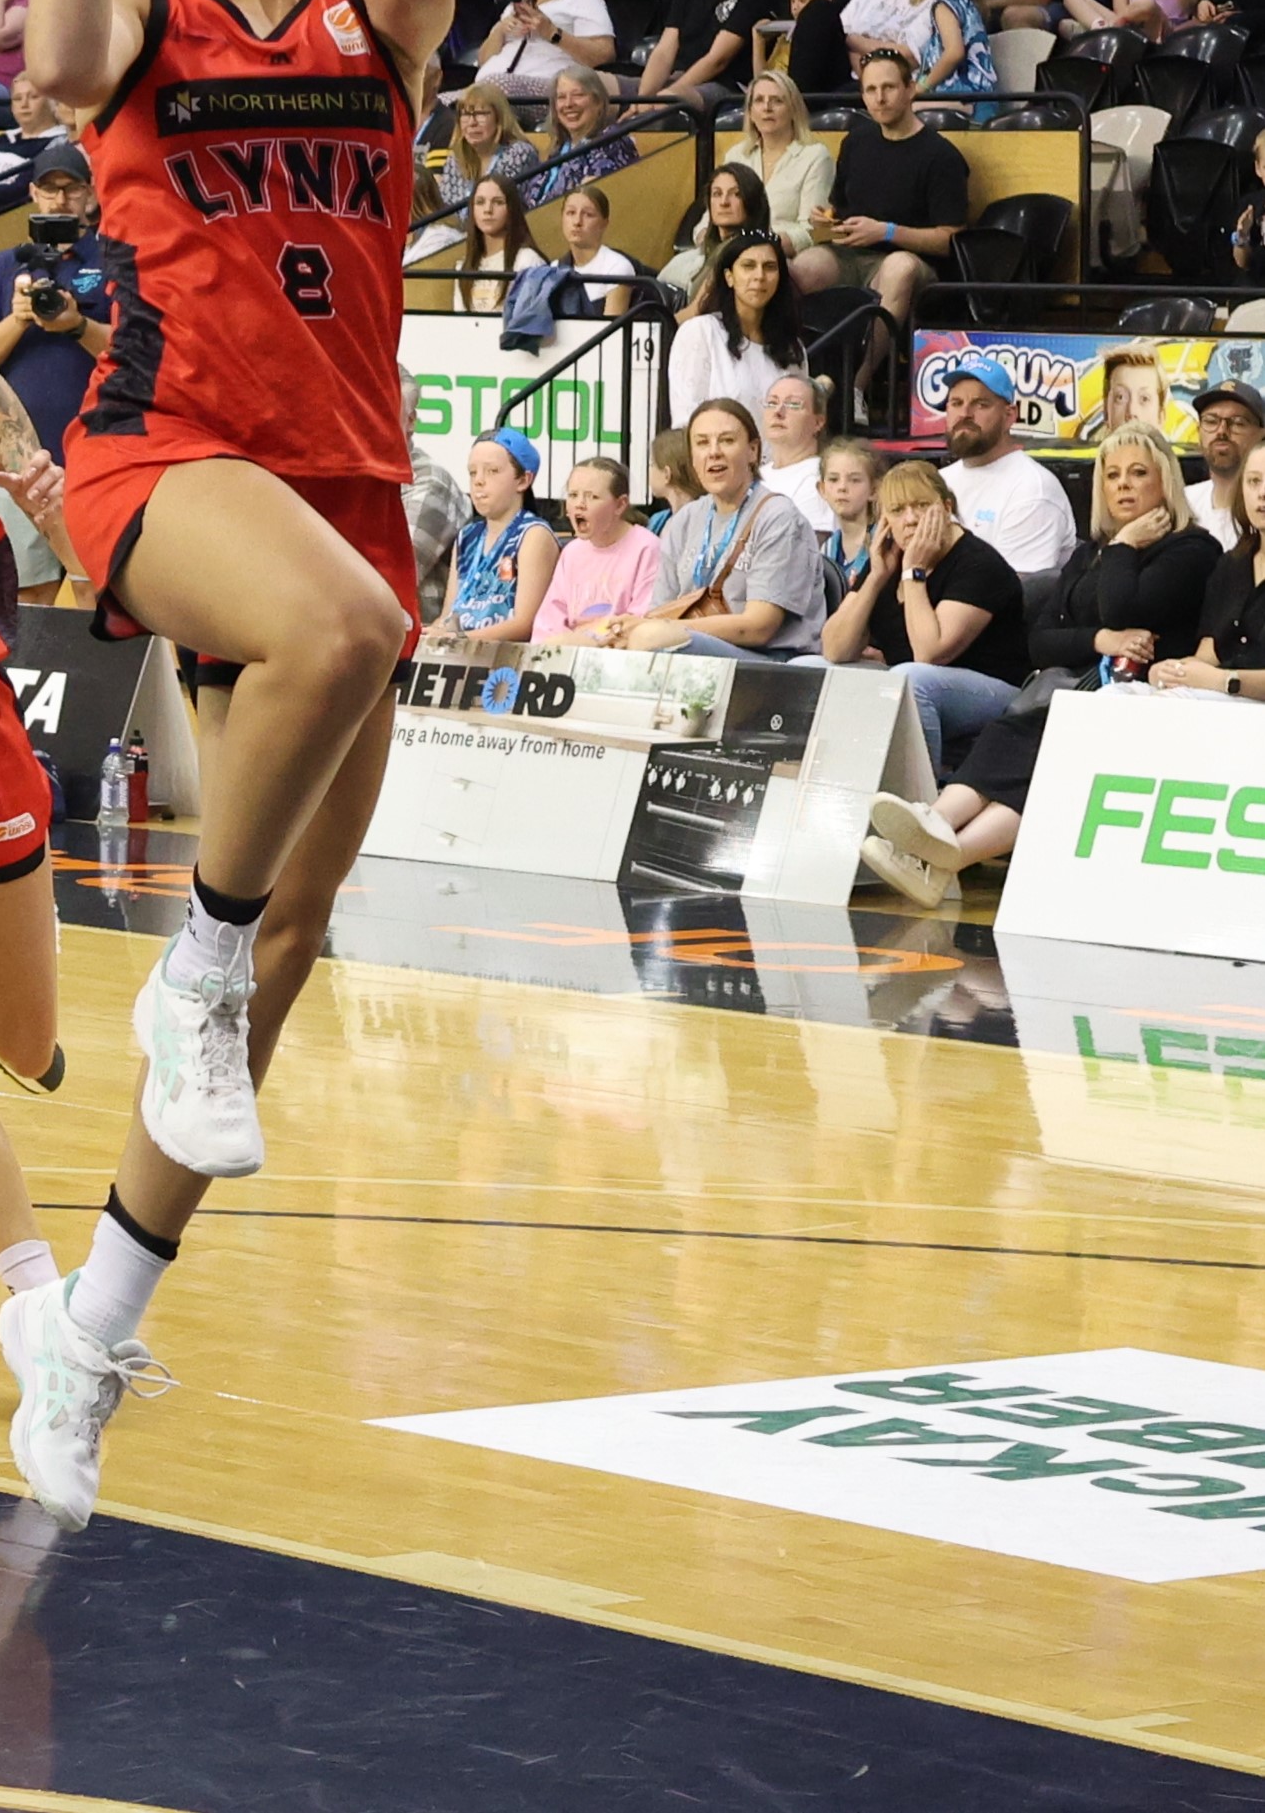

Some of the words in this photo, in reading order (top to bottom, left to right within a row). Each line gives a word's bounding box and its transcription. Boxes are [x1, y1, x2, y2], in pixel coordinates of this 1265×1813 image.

[209, 91, 343, 112] NORTHERN
[164, 138, 391, 228] LYNX
[632, 337, 654, 362] 19
[414, 374, 622, 444] STOOL
[397, 661, 576, 719] HETFORD
[392, 723, 414, 746] ing
[417, 731, 427, 744] a
[431, 727, 474, 748] home
[477, 735, 517, 756] away
[520, 735, 557, 756] from
[561, 738, 606, 760] home
[653, 1405, 1265, 1534] ACKAY
